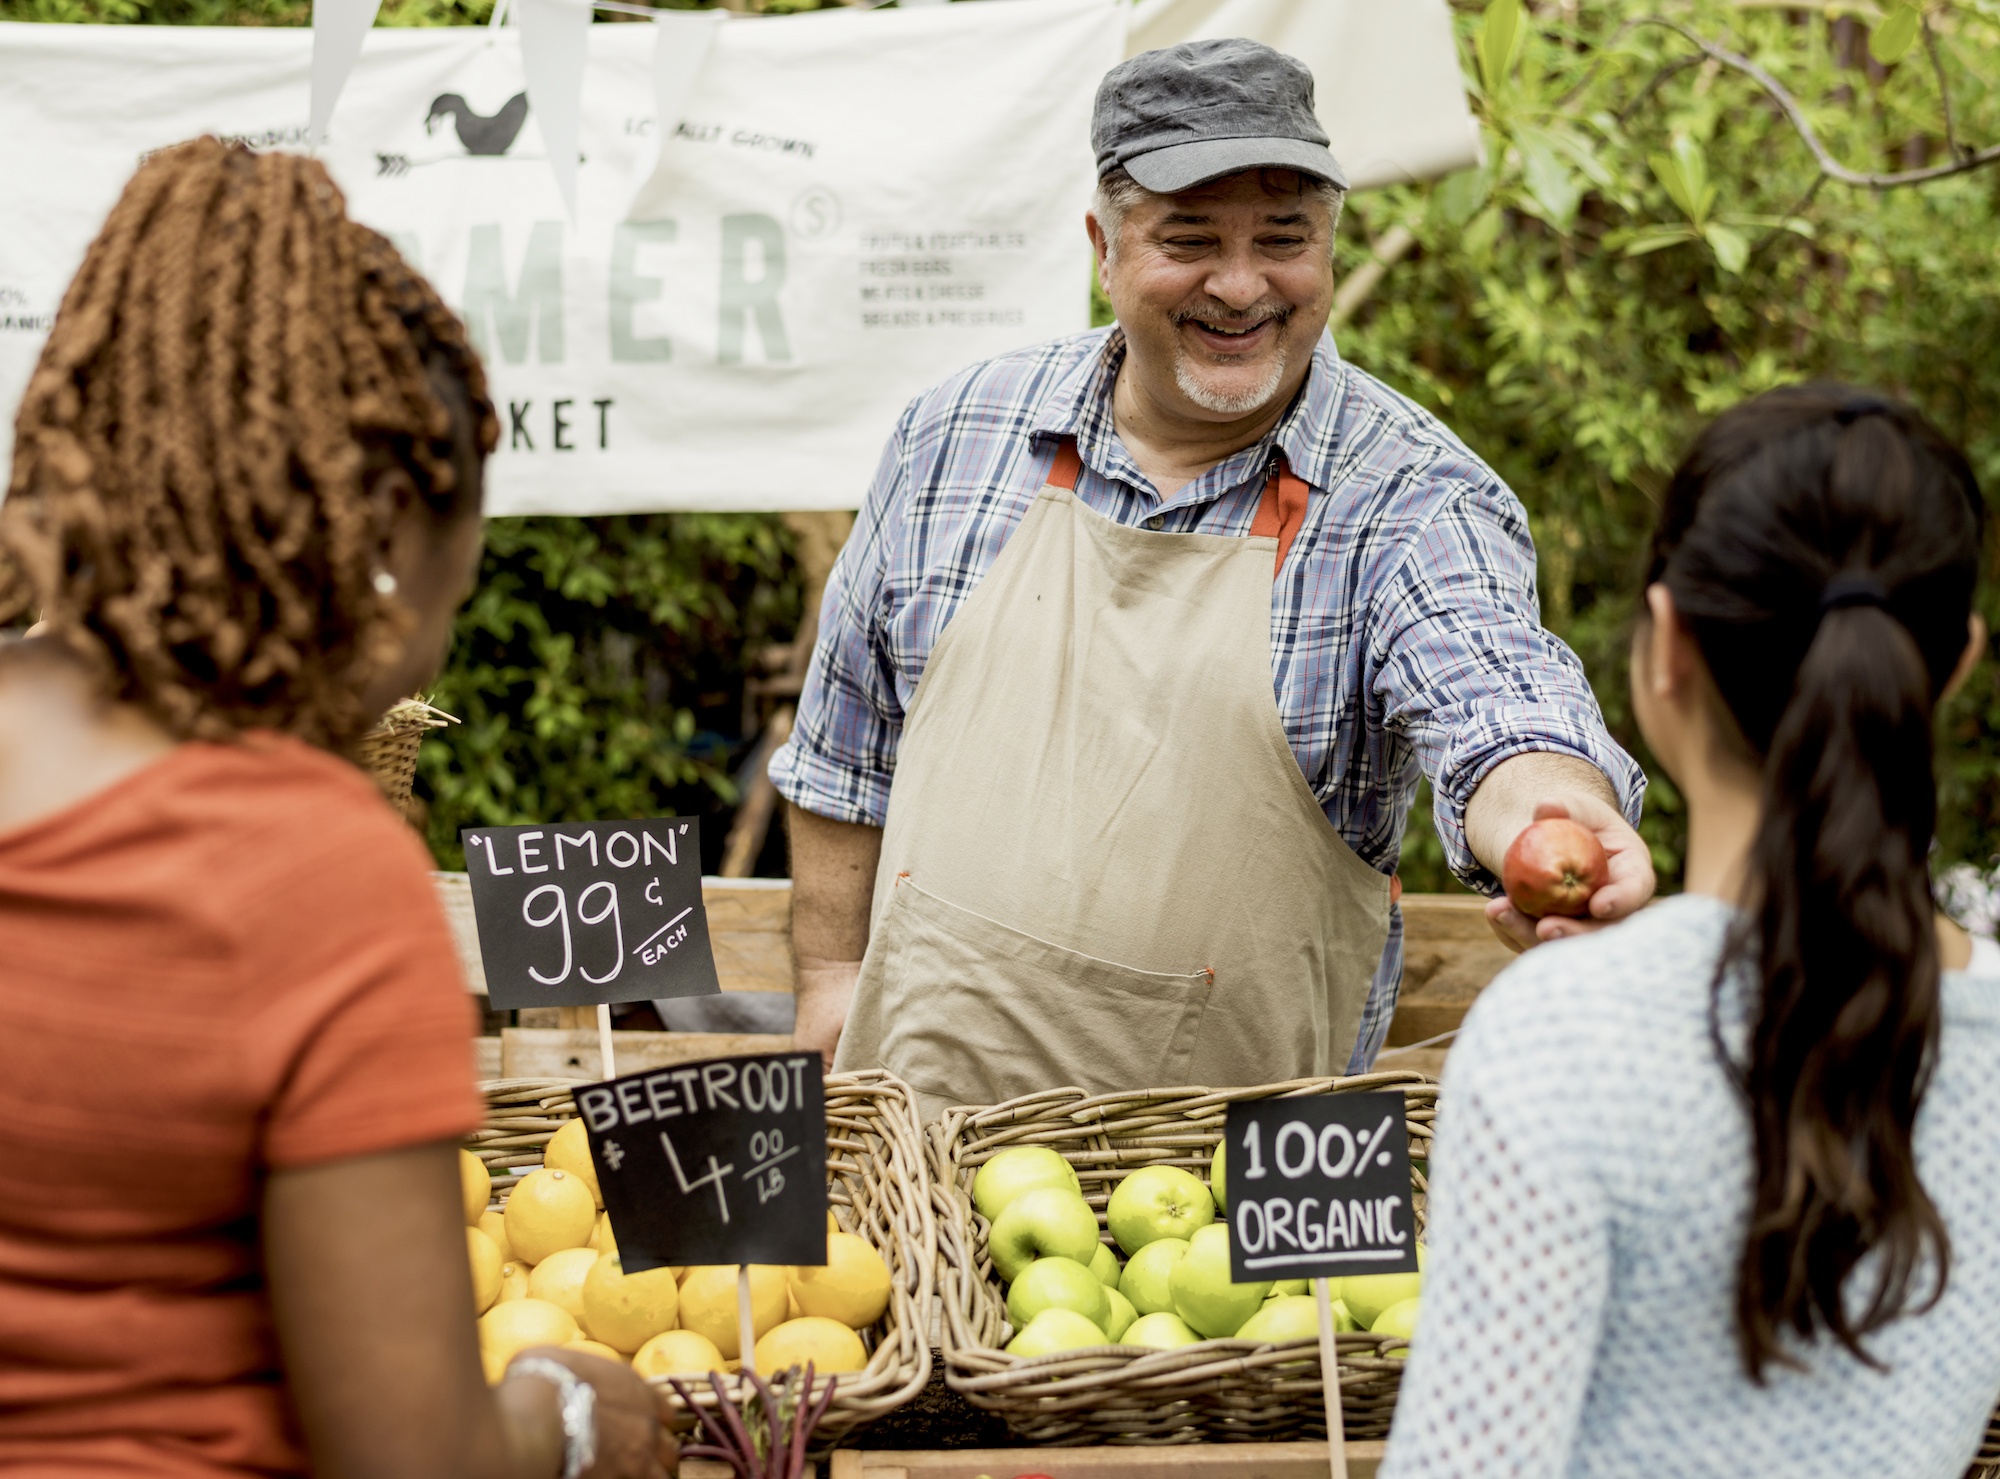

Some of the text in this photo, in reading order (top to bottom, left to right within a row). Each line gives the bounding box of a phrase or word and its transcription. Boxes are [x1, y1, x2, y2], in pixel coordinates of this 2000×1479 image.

[641, 924, 688, 966] EACH
[579, 1057, 808, 1133] BEETROOT
[1242, 1114, 1393, 1180] 100%
[1236, 1195, 1407, 1254] ORGANIC
